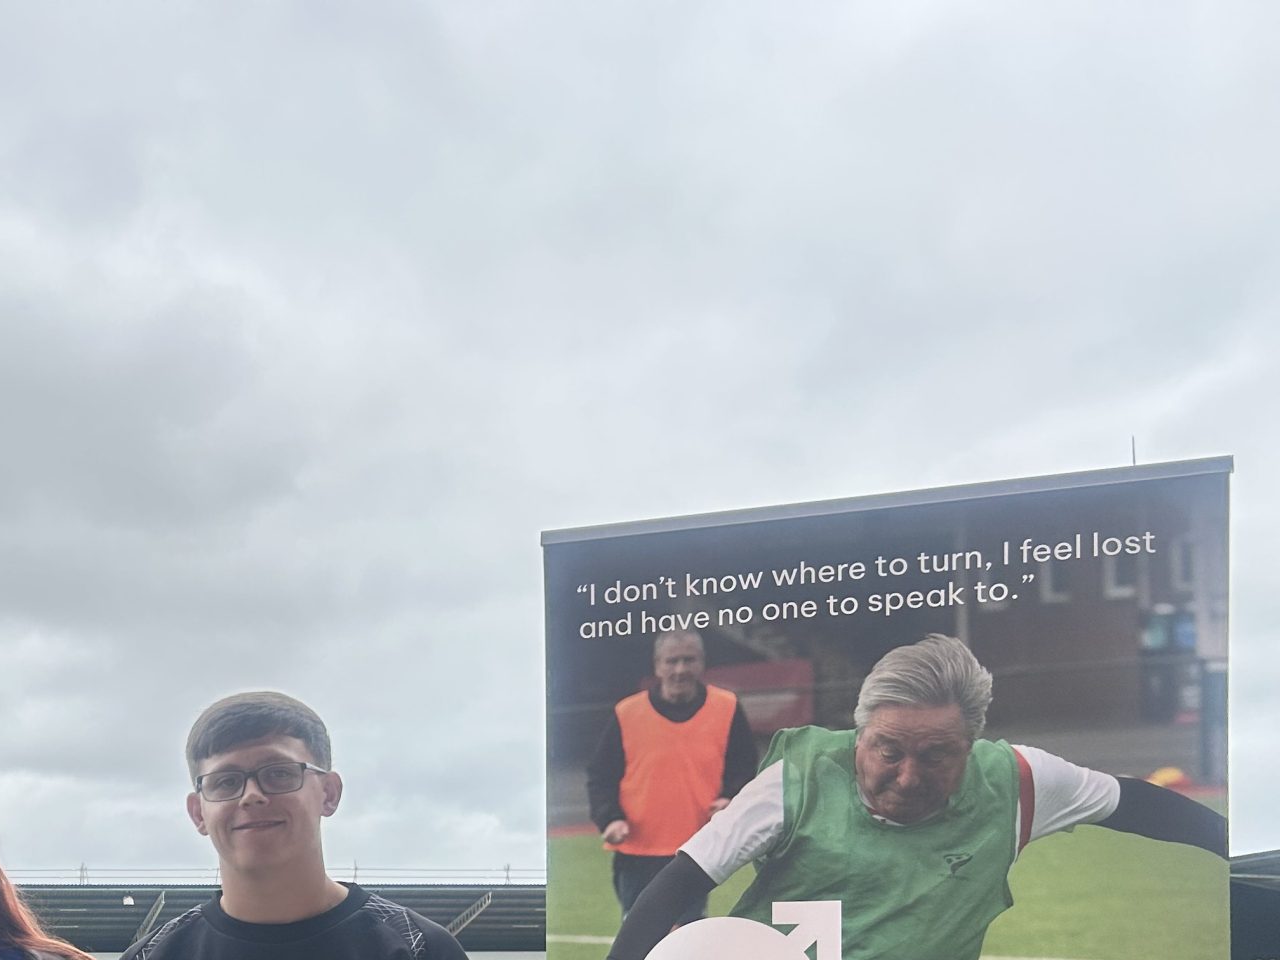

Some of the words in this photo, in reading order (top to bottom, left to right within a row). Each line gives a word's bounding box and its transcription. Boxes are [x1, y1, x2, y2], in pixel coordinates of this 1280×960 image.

[604, 576, 677, 604] don't
[686, 571, 763, 596] know
[772, 561, 866, 586] where
[875, 556, 908, 577] to
[917, 551, 992, 573] turn,
[1004, 541, 1009, 565] I
[1020, 534, 1081, 563] feel
[1093, 531, 1156, 557] lost
[579, 612, 632, 639] and
[641, 611, 710, 633] have
[718, 606, 753, 626] no
[762, 600, 817, 620] one
[826, 595, 858, 616] to
[868, 581, 965, 616] speak
